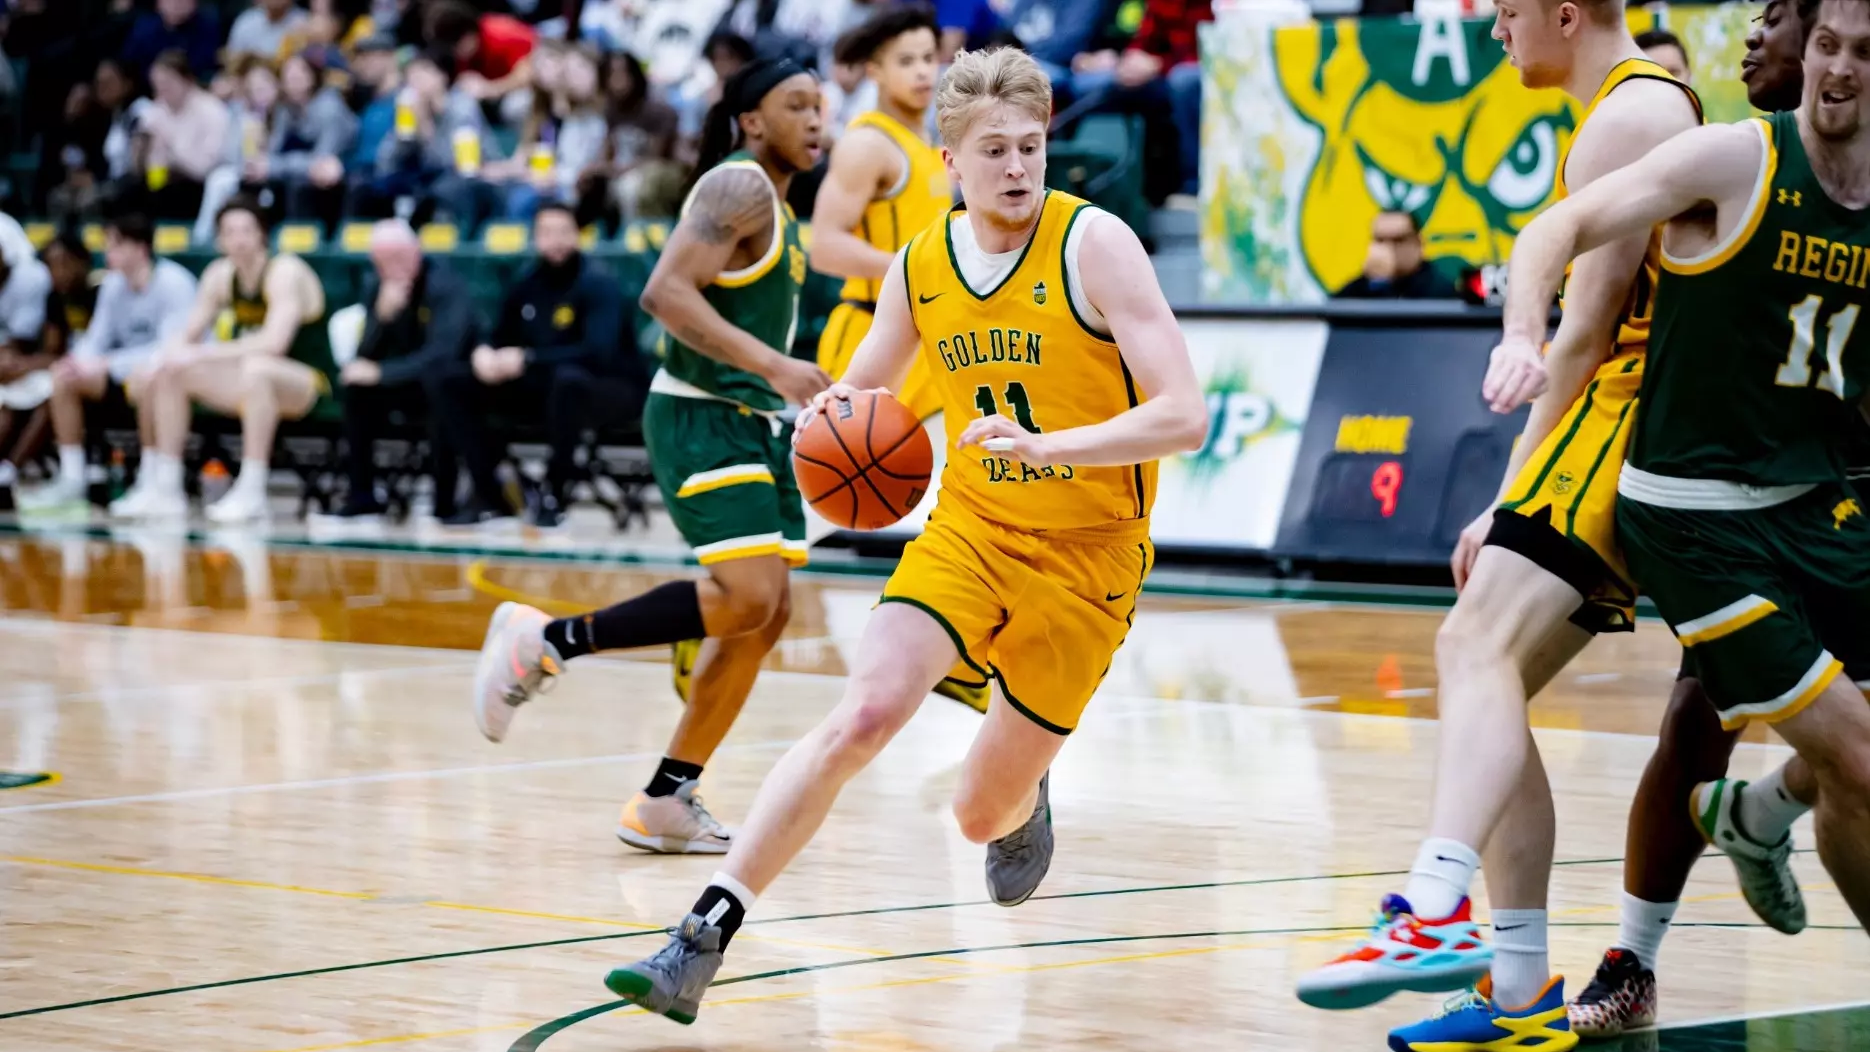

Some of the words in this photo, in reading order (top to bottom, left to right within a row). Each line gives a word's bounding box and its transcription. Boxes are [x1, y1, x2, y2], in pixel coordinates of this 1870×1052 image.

[1411, 7, 1470, 87] A
[938, 328, 1042, 372] GOLDEN
[1774, 293, 1861, 400] 11
[974, 381, 1042, 434] 11
[1371, 461, 1403, 518] 9
